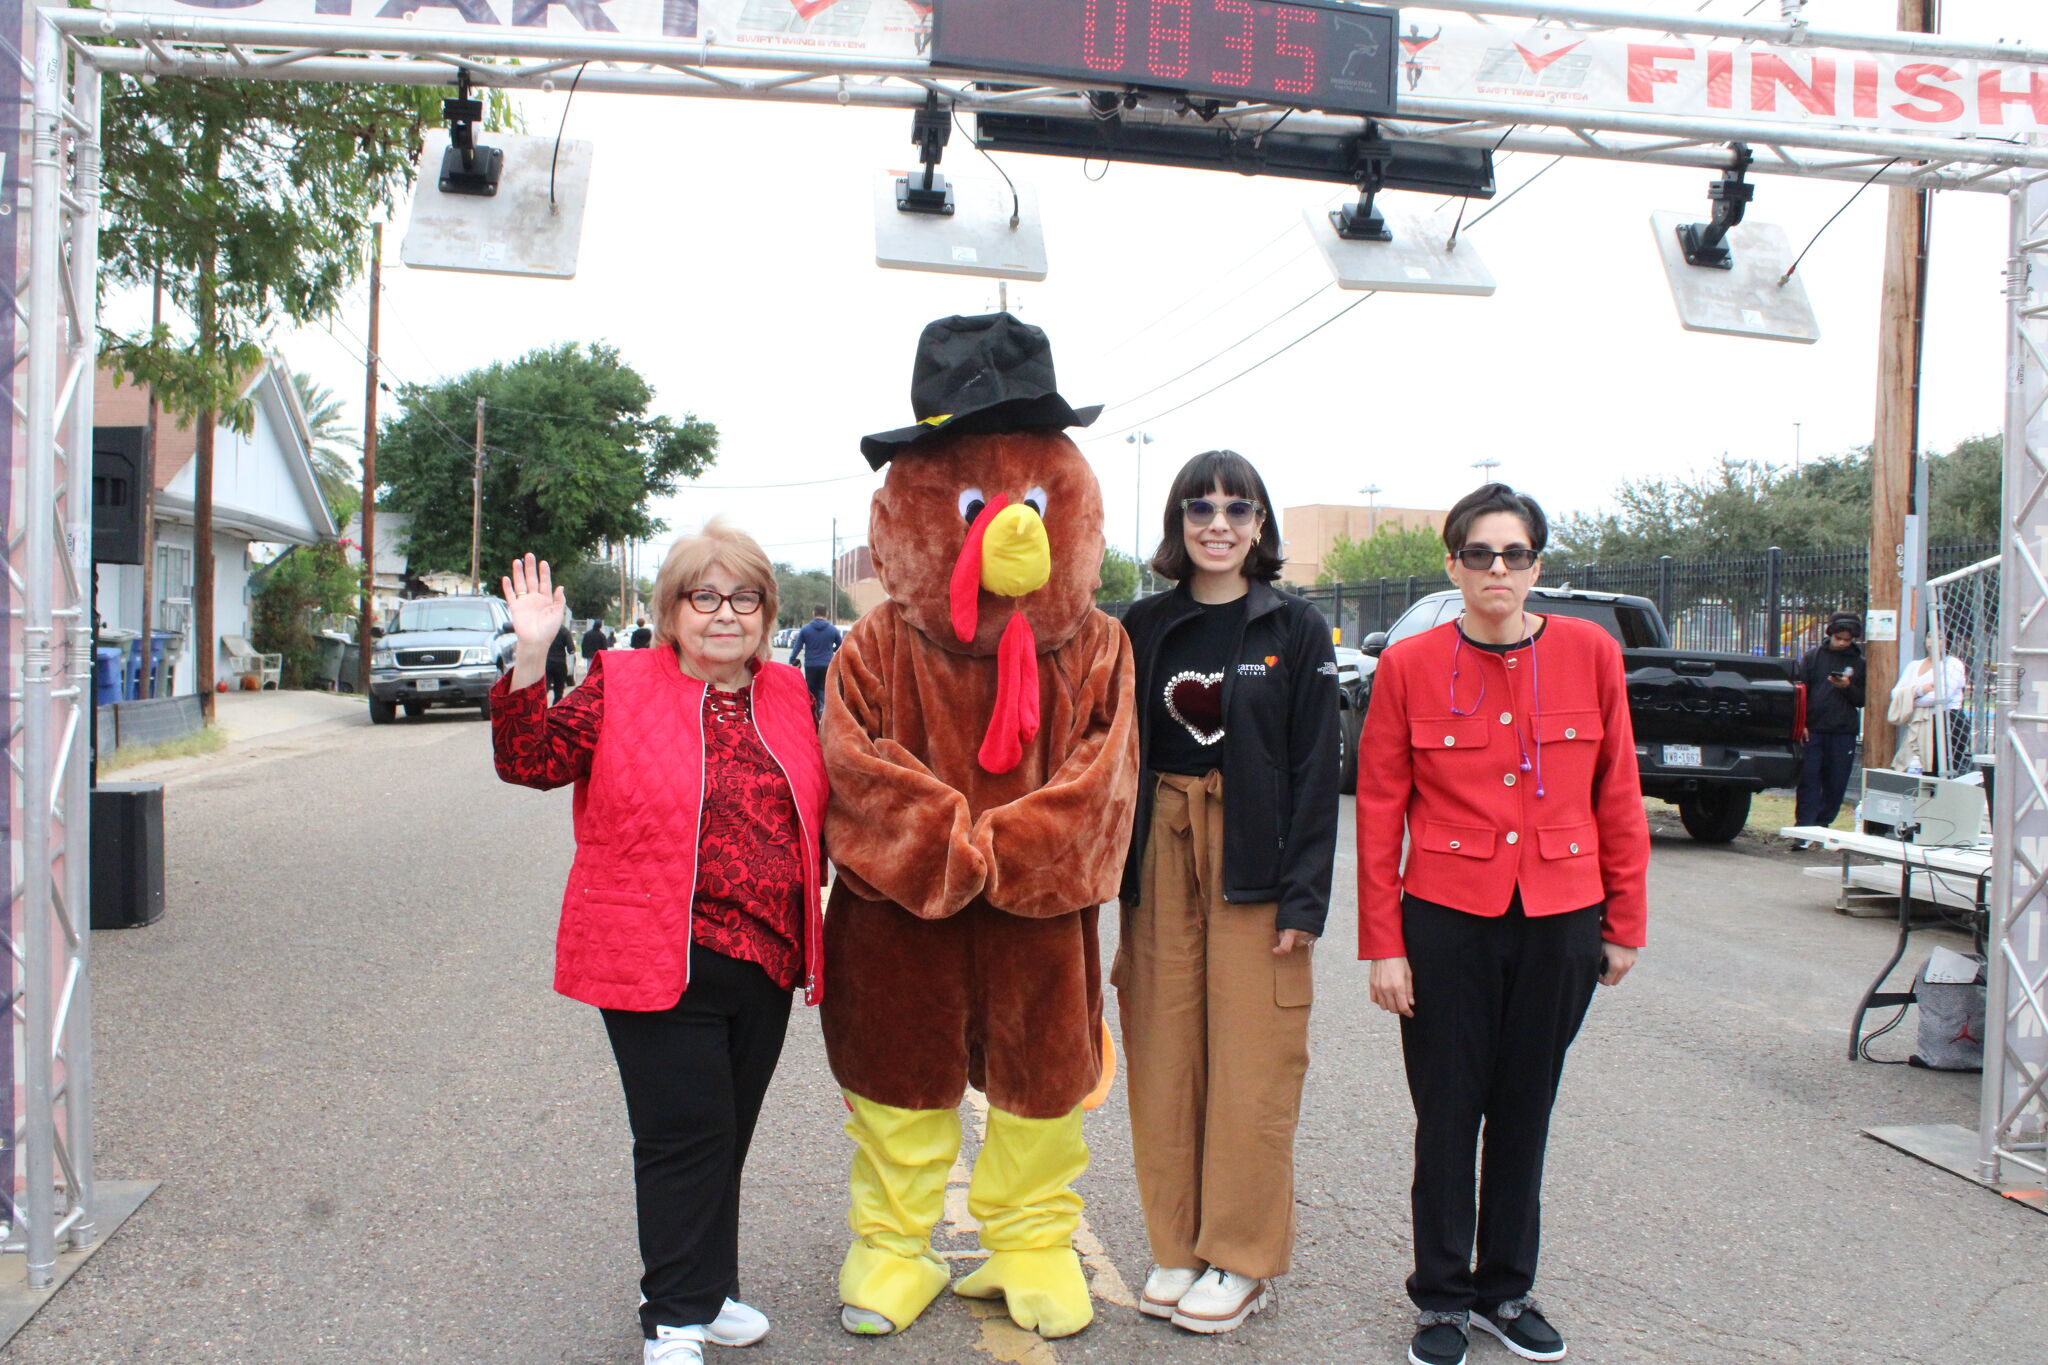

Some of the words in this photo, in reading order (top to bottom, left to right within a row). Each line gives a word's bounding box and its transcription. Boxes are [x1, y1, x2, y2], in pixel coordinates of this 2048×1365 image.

[736, 34, 772, 44] SWIFT
[776, 36, 816, 47] TIMING
[1626, 43, 2048, 126] FINISH
